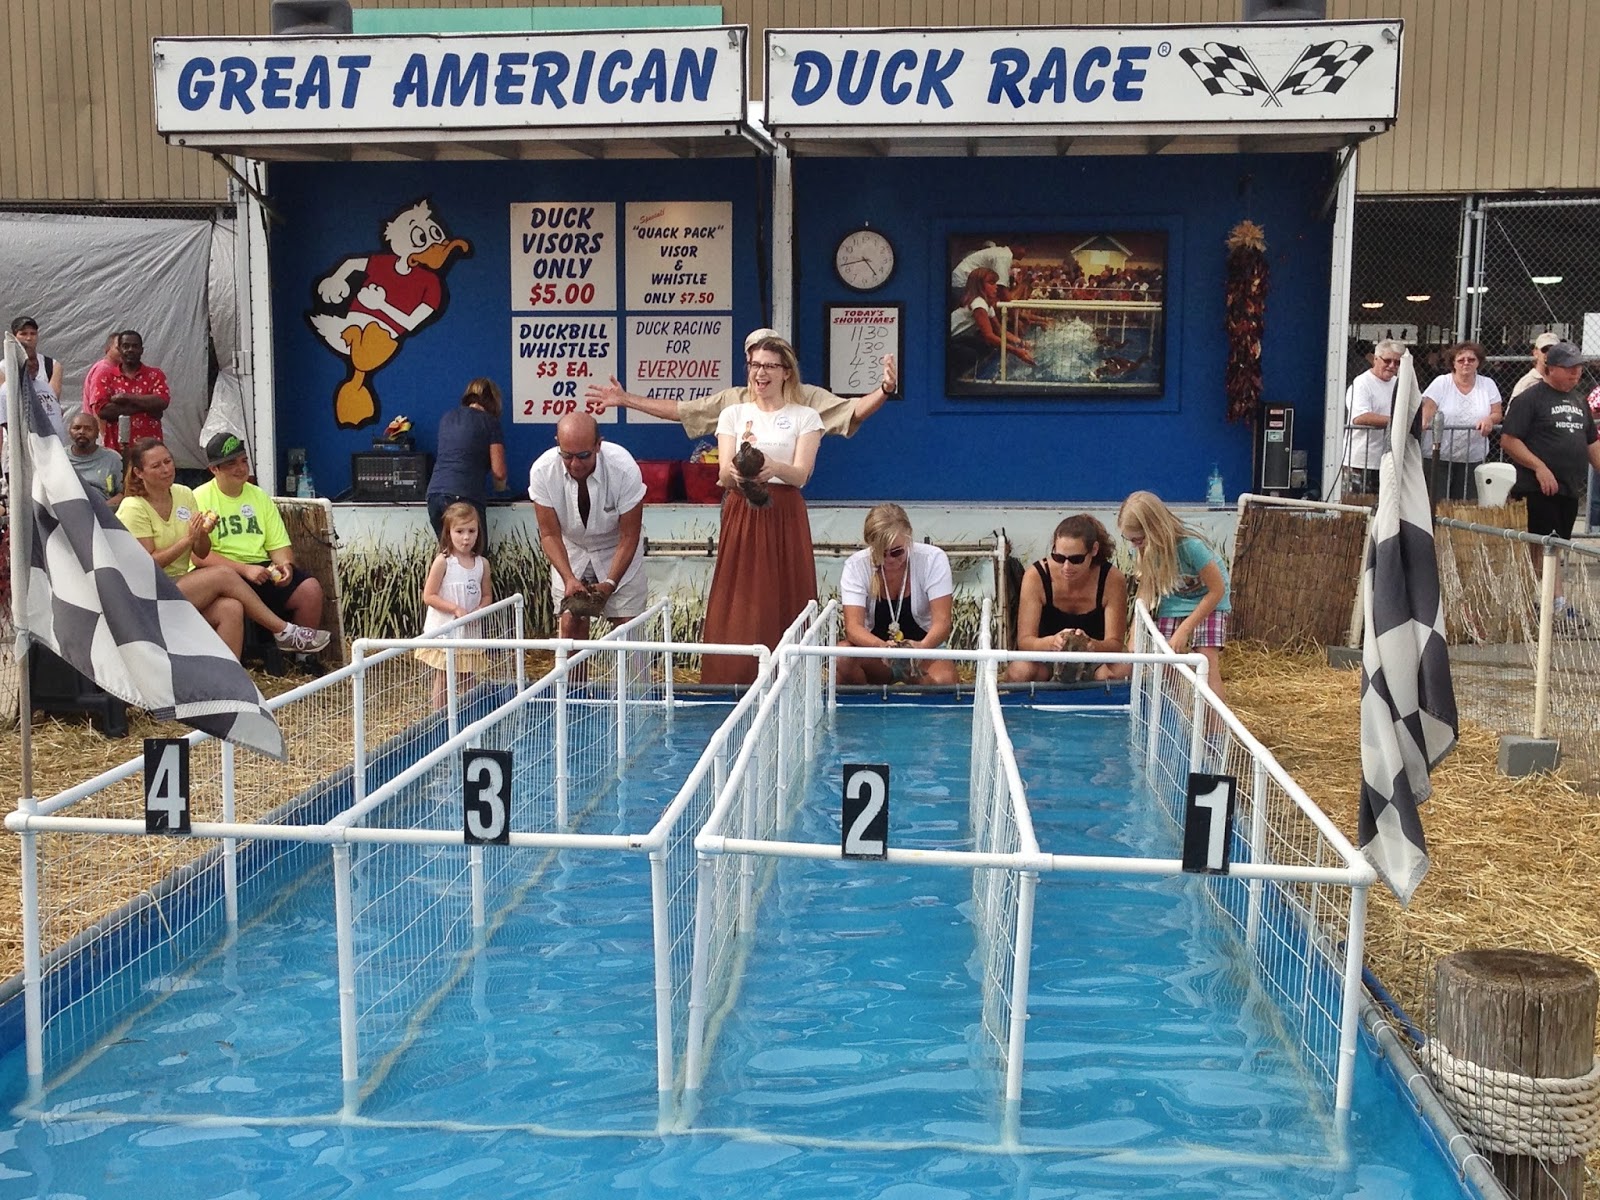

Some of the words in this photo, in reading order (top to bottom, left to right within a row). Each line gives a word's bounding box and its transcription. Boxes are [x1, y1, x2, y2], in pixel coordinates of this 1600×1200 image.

[177, 54, 371, 115] GREAT
[392, 47, 718, 111] AMERICAN
[790, 48, 965, 110] DUCK
[987, 46, 1152, 109] RACE
[531, 207, 595, 229] DUCK
[522, 232, 604, 255] VISORS
[660, 245, 699, 258] VISOR
[533, 257, 593, 279] ONLY
[674, 259, 684, 271] &
[651, 273, 707, 286] WHISTLE
[529, 282, 595, 306] $5.00
[644, 292, 676, 305] ONLY
[680, 292, 715, 305] $7.50
[636, 321, 669, 336] DUCK
[673, 321, 722, 336] RACING
[833, 316, 896, 324] SHOWTIMES
[519, 323, 608, 340] DUCKBILL
[519, 341, 610, 359] WHISTLES
[666, 339, 691, 355] FOR
[536, 360, 559, 379] $3
[566, 361, 594, 378] EA.
[637, 360, 721, 378] EVERYONE
[552, 380, 577, 398] OR
[647, 387, 685, 401] AFTER
[523, 399, 534, 416] 2
[542, 399, 577, 416] FOR
[1555, 421, 1584, 430] HOCKEY
[217, 514, 263, 539] USA
[149, 744, 186, 830] 4
[466, 757, 504, 842] 3
[845, 769, 886, 856] 2
[1195, 780, 1231, 870] 1
